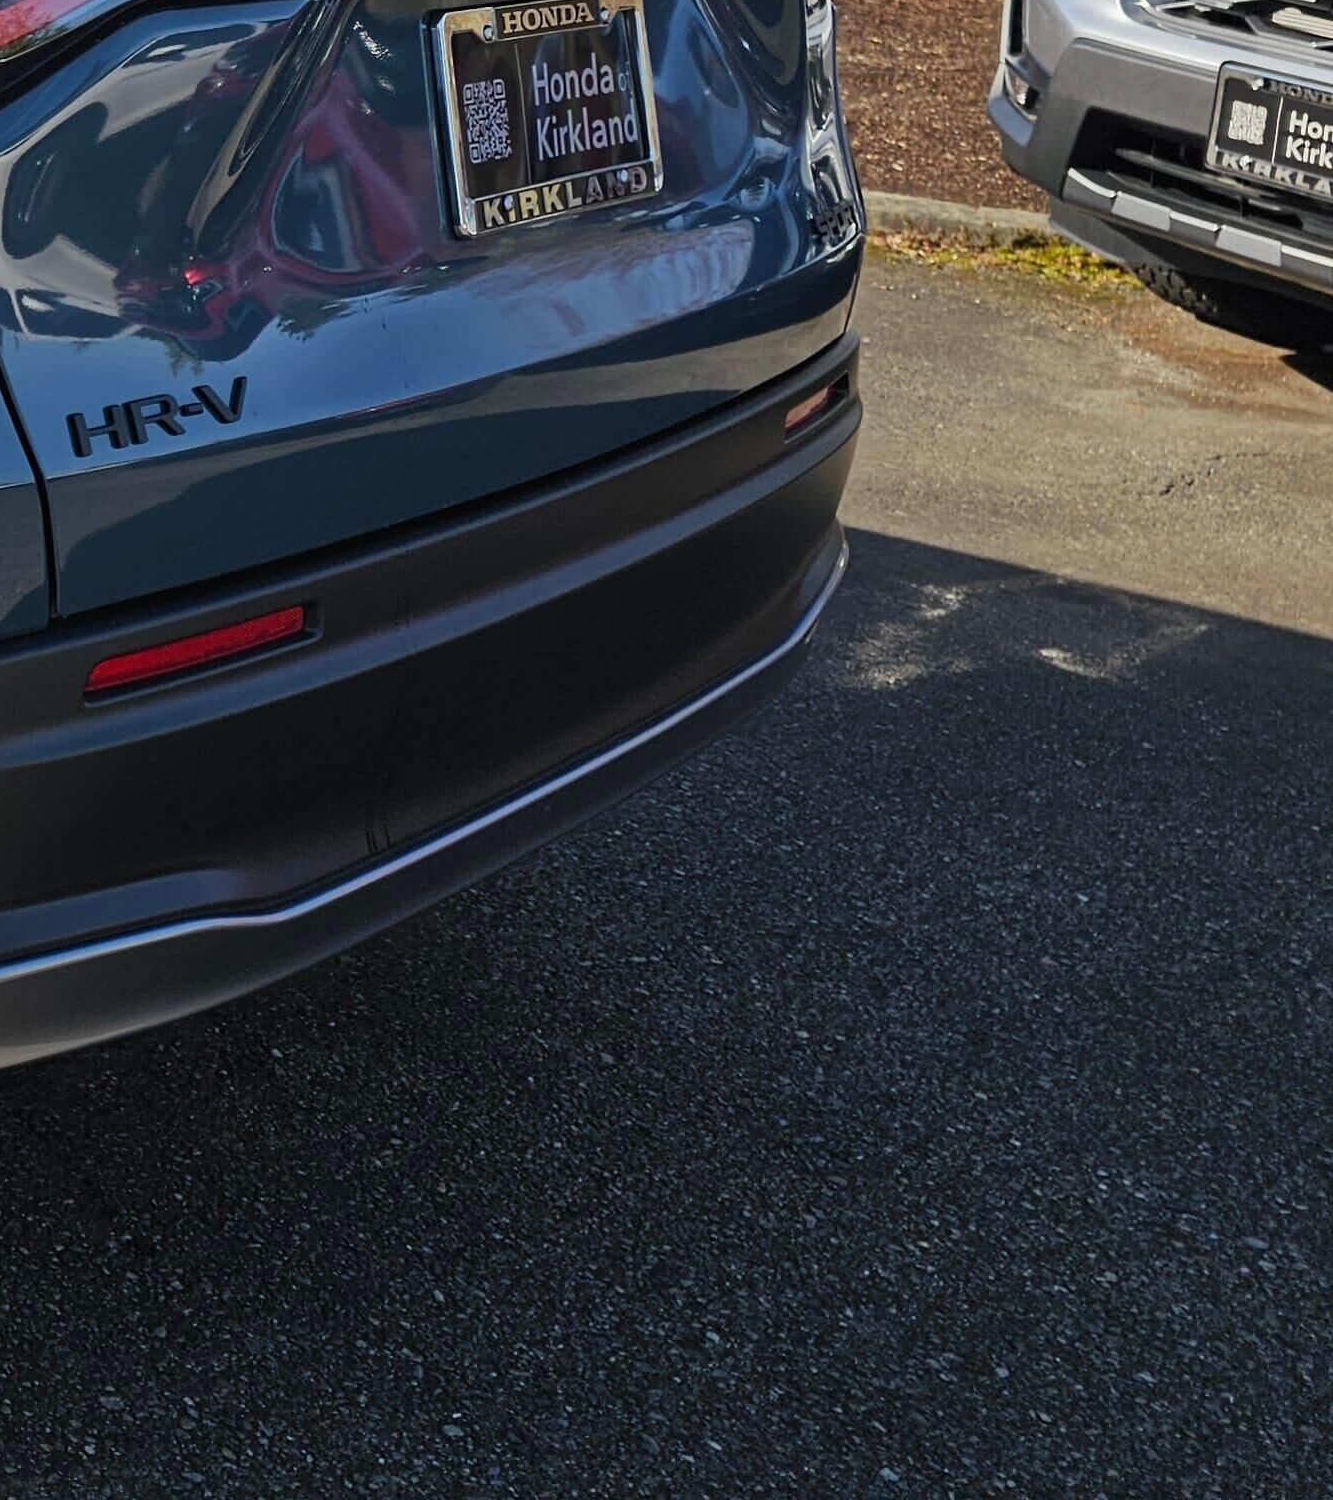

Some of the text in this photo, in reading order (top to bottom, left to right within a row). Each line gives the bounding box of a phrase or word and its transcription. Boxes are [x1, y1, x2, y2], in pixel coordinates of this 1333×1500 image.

[501, 2, 595, 34] HONDA
[531, 52, 614, 106] Honda
[535, 98, 639, 160] Kirkland
[66, 376, 247, 458] HR-V
